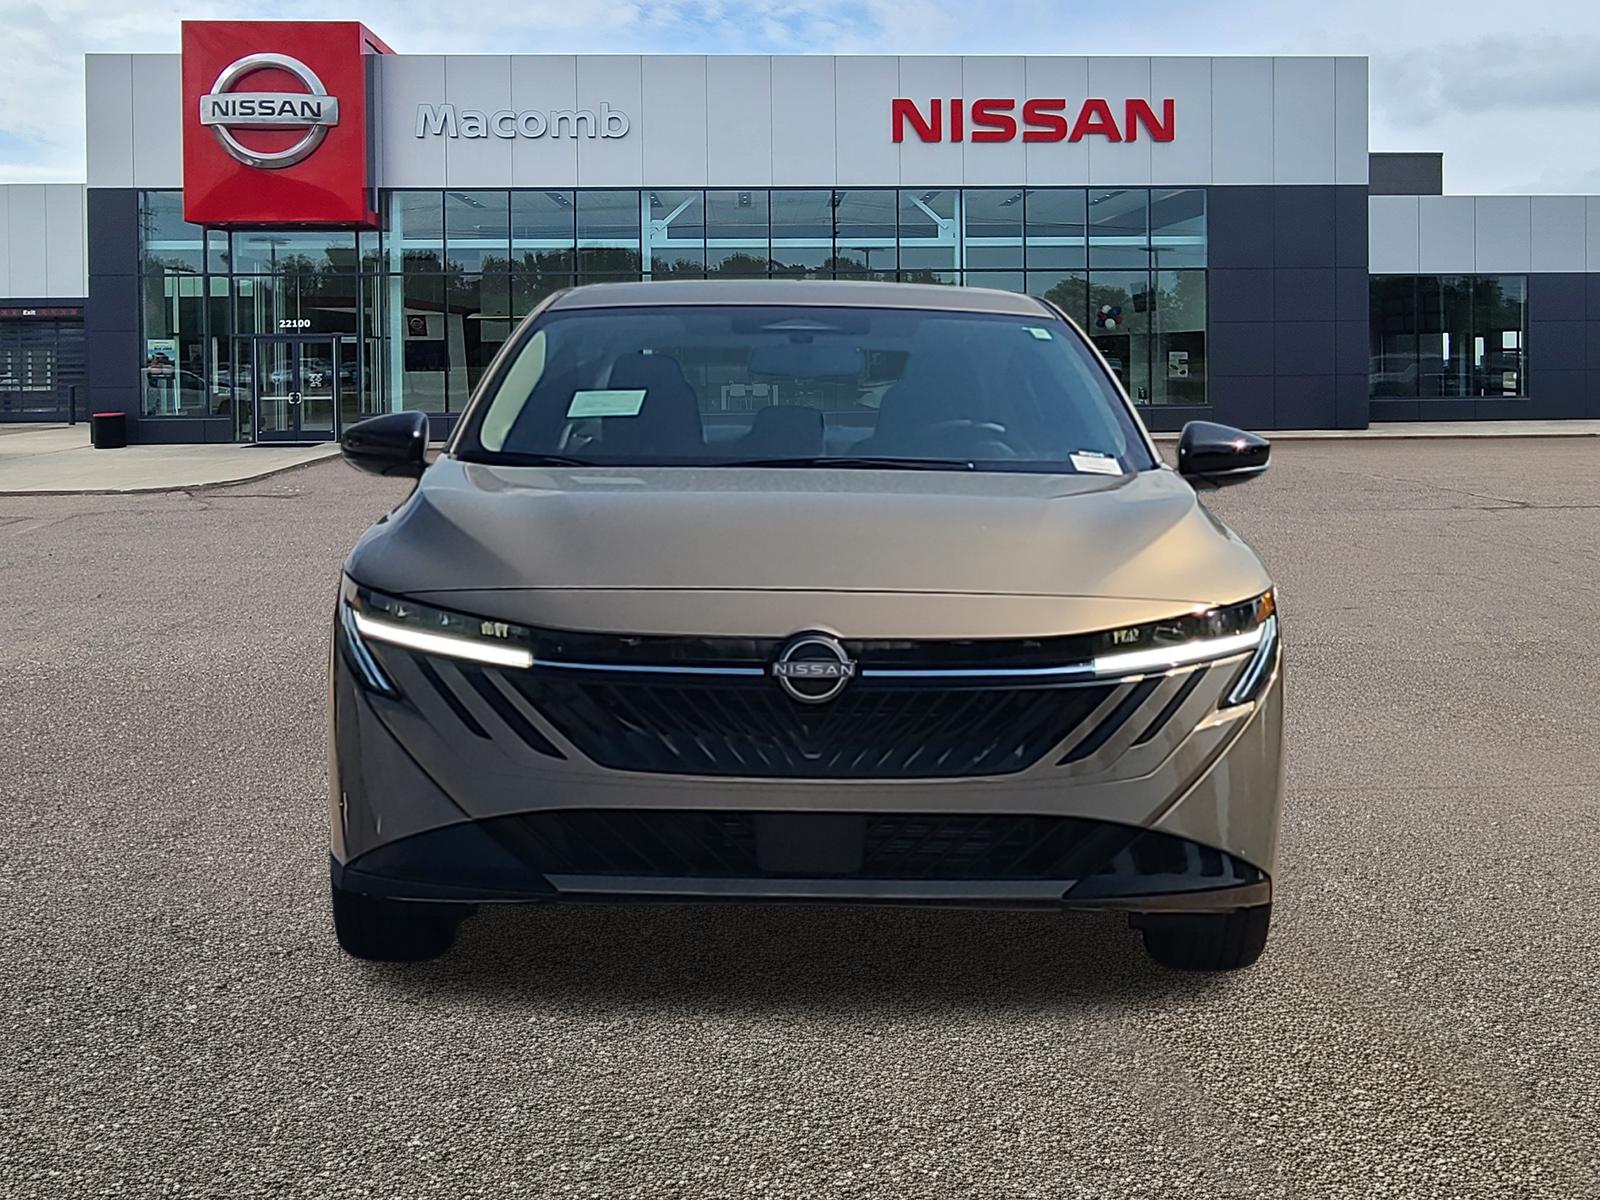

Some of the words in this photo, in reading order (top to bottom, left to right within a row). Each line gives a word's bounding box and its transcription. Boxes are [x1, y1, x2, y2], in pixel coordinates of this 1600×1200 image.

[212, 100, 322, 118] NISSAN
[415, 101, 631, 139] Macomb
[892, 98, 1175, 143] NISSAN
[279, 319, 311, 328] 22100
[774, 663, 854, 675] NISSAN
